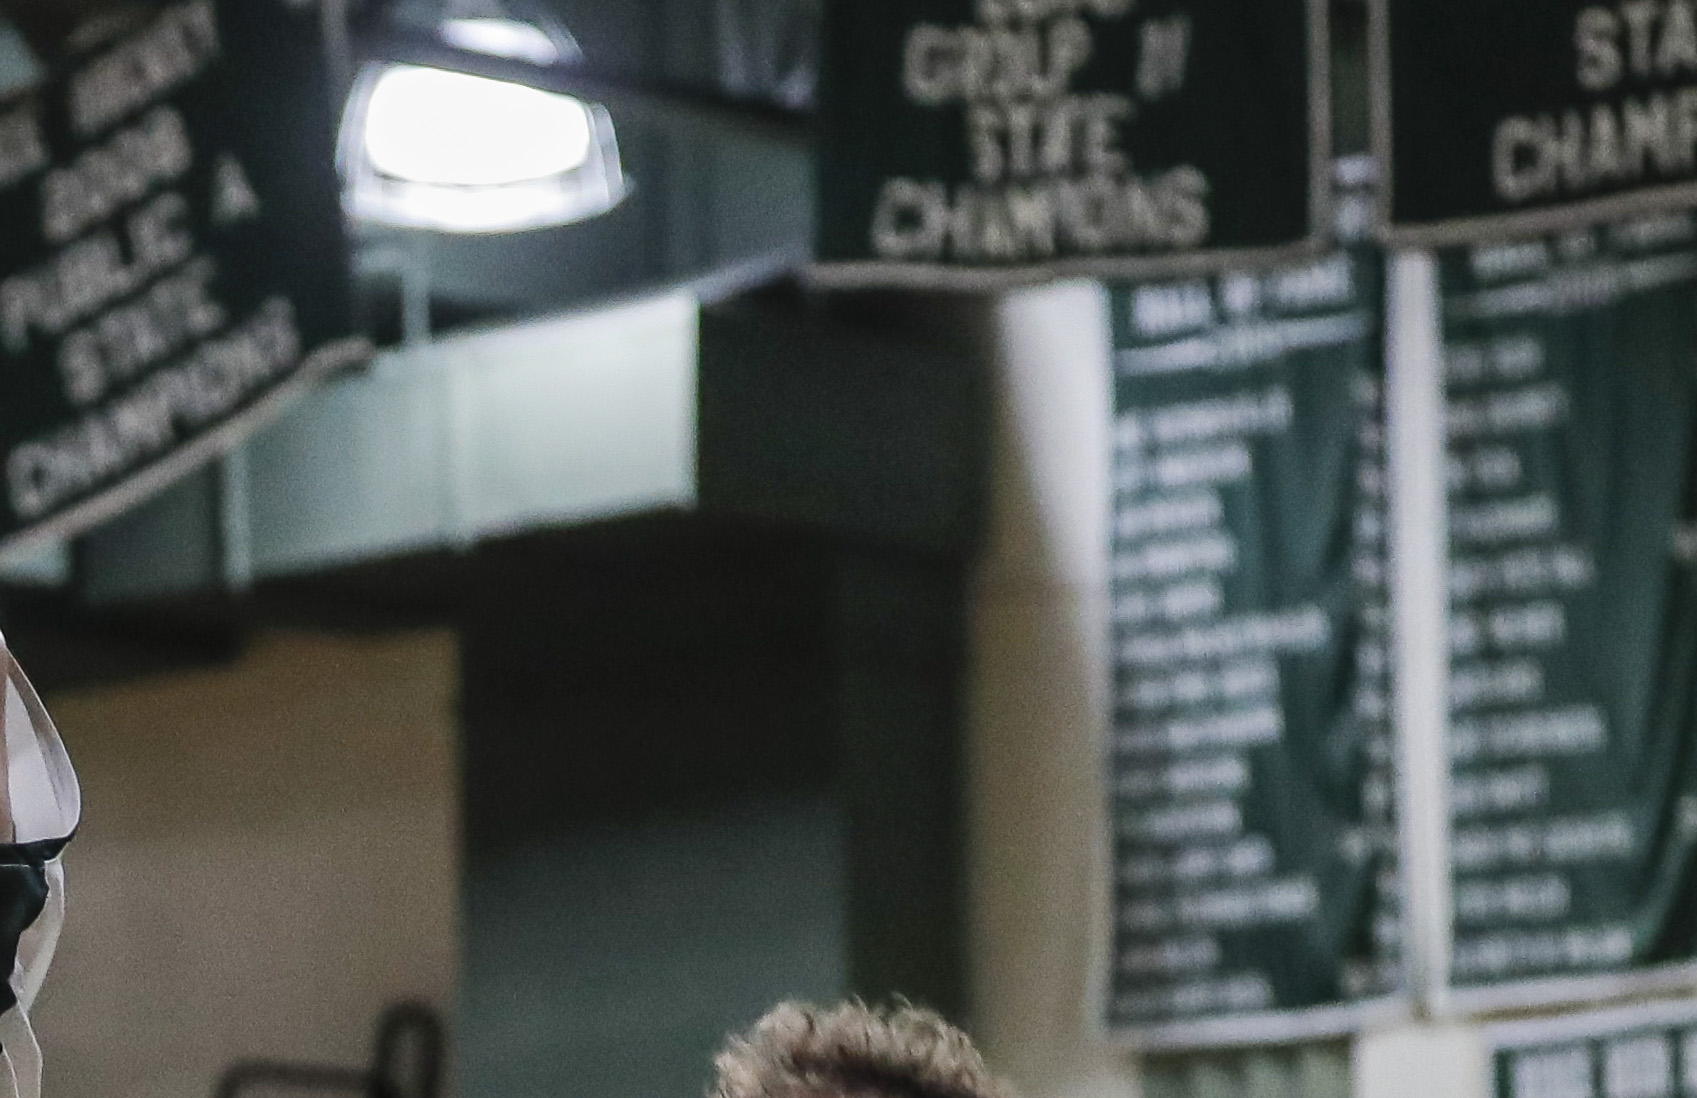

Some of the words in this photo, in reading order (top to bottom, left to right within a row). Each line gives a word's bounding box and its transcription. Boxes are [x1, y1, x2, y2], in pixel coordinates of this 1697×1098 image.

[968, 92, 1138, 183] STATE
[872, 166, 1210, 257] CHAMPIONS
[8, 296, 300, 517] CHAMPIONS
